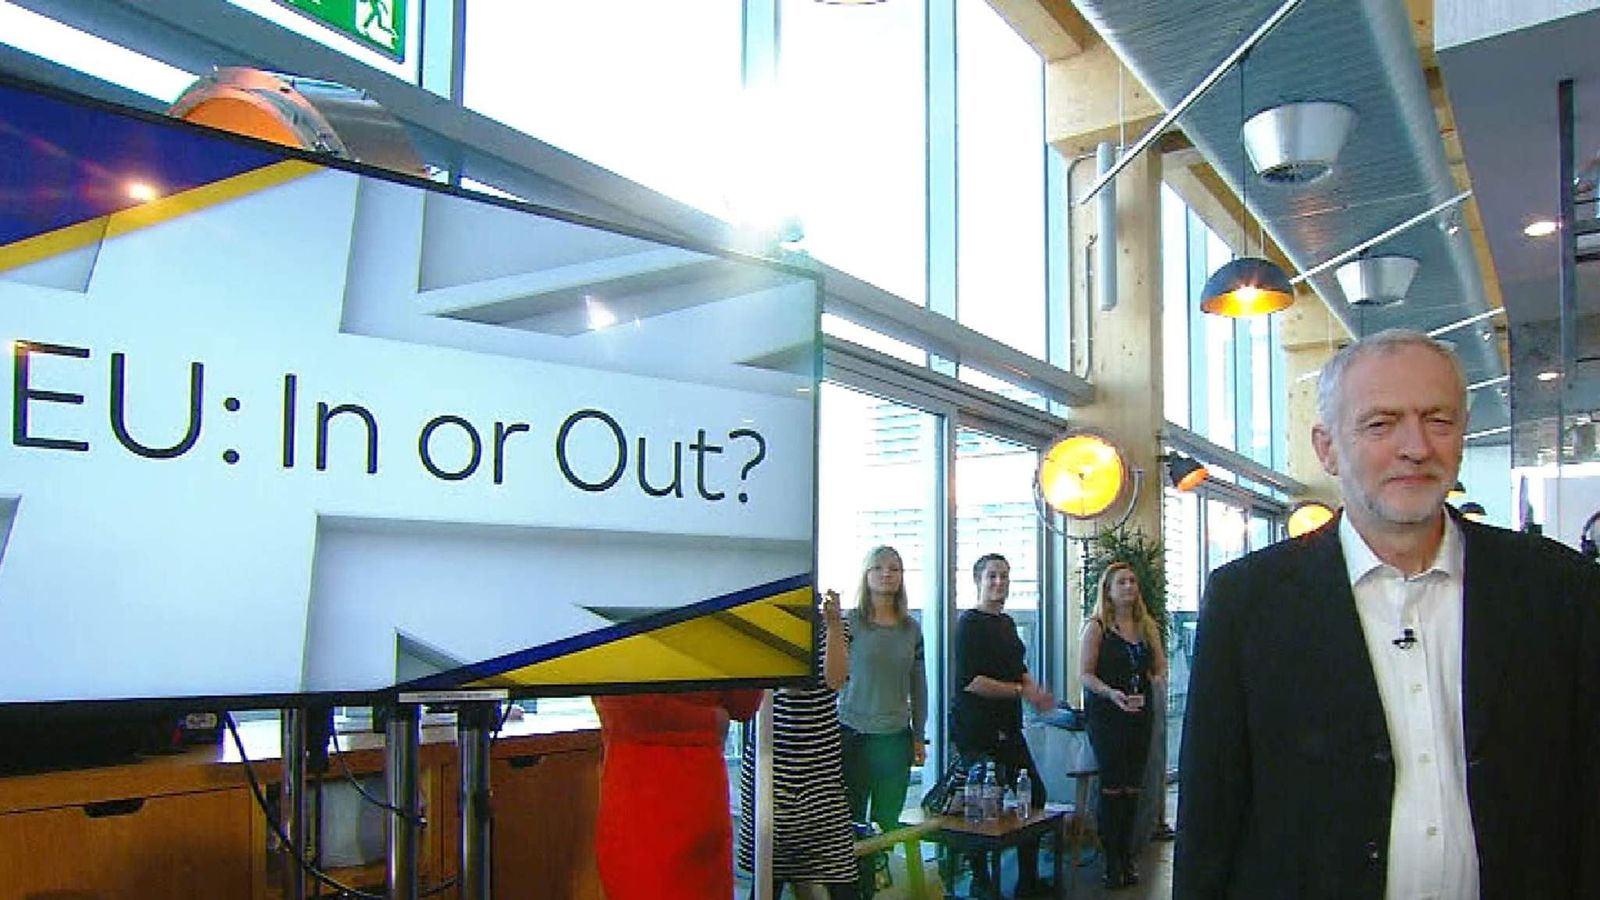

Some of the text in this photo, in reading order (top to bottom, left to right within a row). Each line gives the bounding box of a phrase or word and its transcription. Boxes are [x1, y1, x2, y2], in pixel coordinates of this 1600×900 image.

[12, 341, 766, 503] EU: In or Out?
